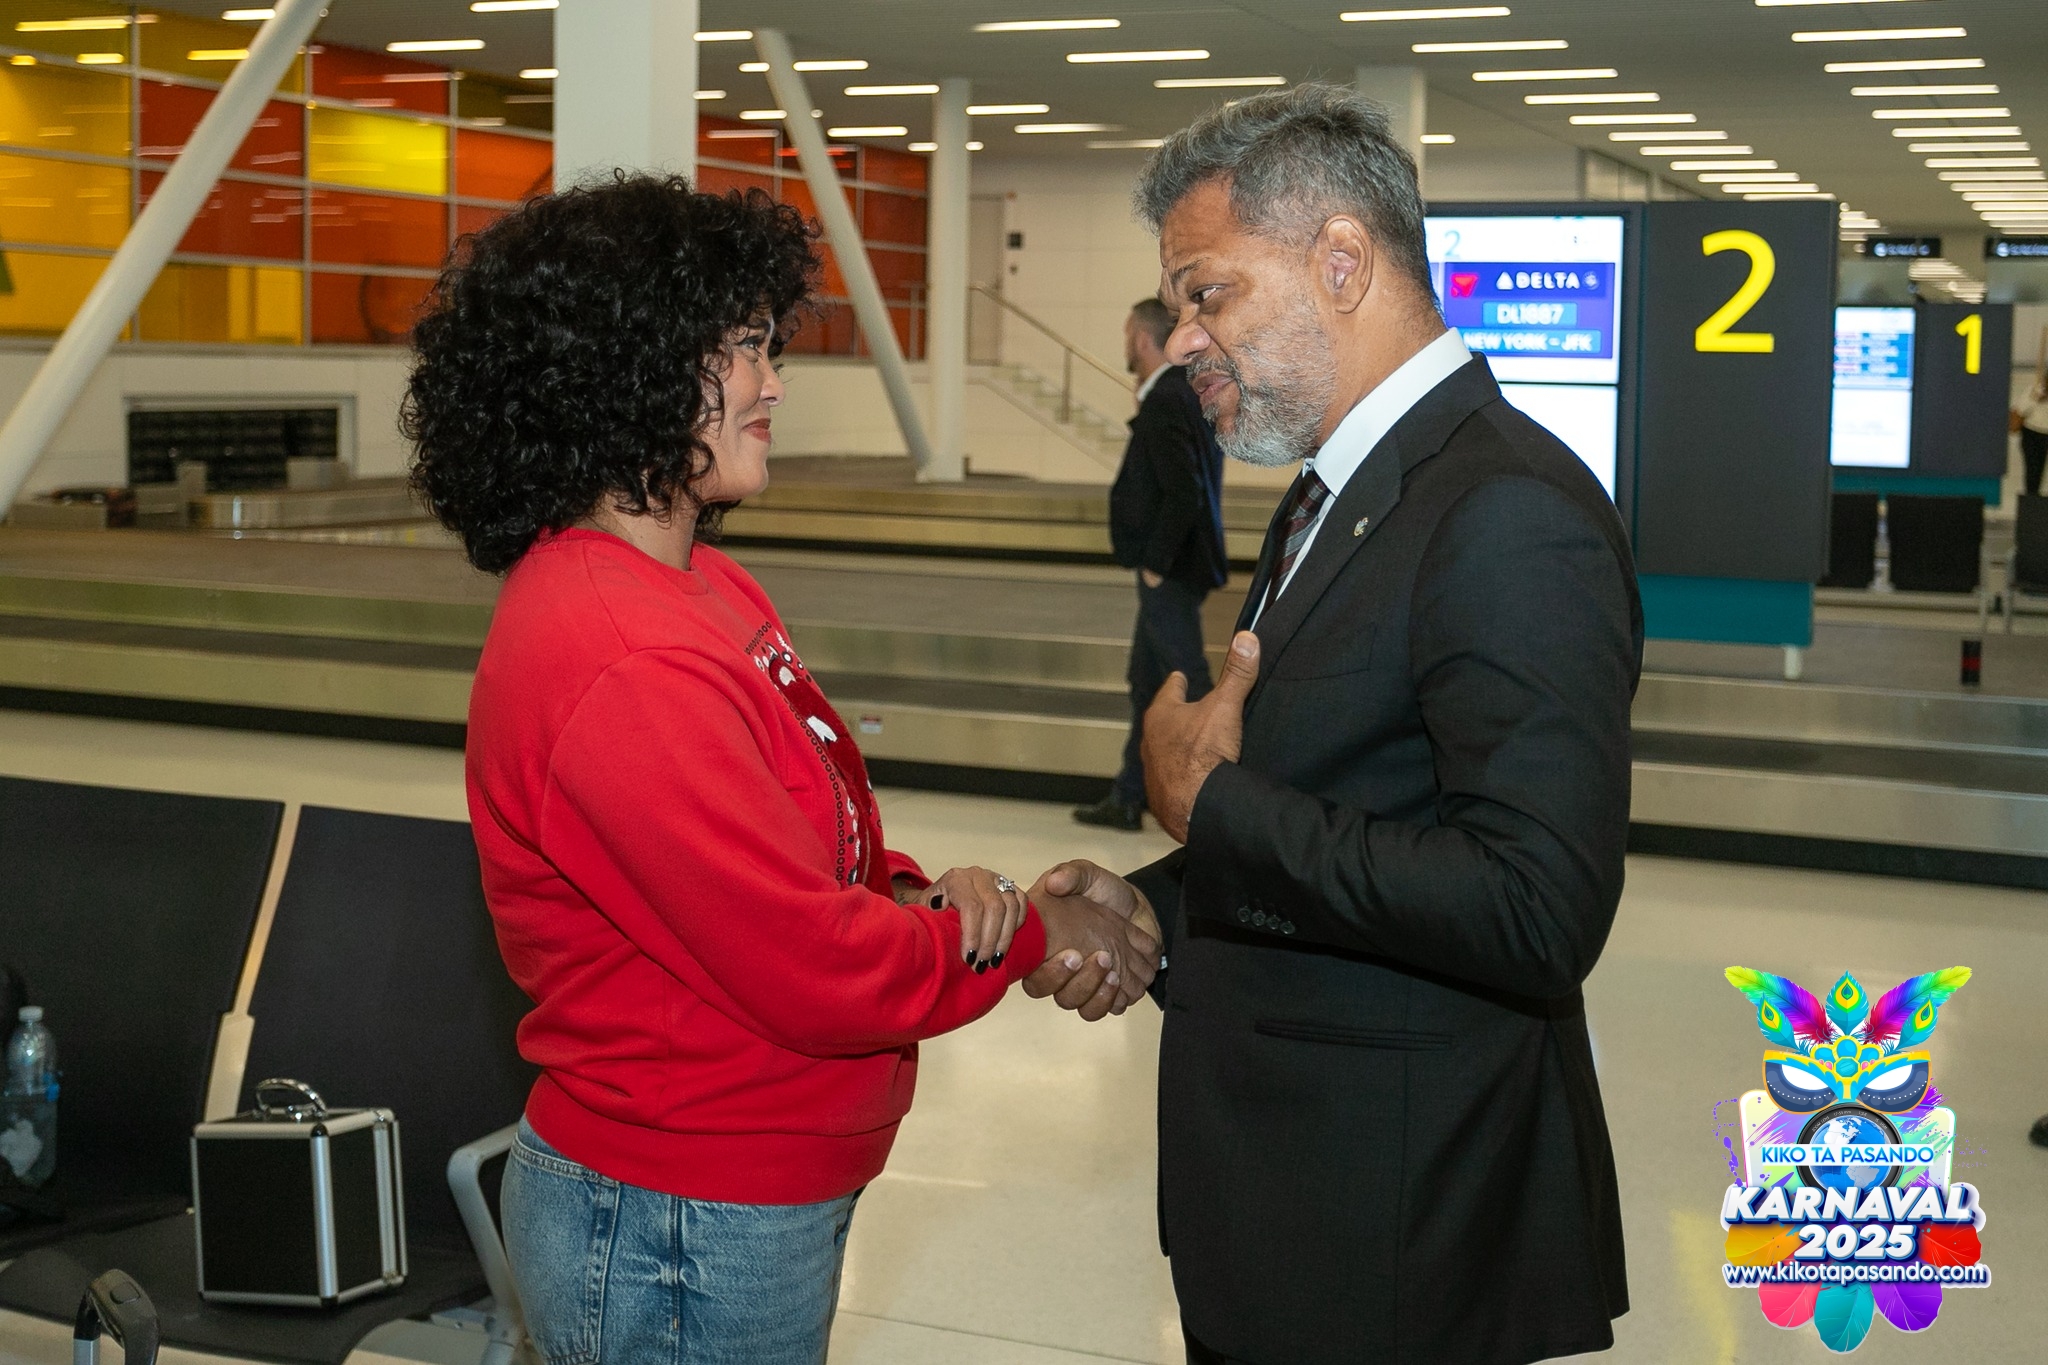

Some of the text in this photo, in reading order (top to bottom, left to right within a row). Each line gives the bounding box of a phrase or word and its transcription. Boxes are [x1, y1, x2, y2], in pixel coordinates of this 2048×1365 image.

[1444, 229, 1462, 259] 2
[1515, 270, 1581, 290] DELTA
[1695, 229, 1776, 354] 2
[1463, 331, 1502, 351] NEW
[1502, 332, 1549, 352] YORK
[1562, 333, 1594, 353] JFK
[1955, 313, 1983, 375] 1
